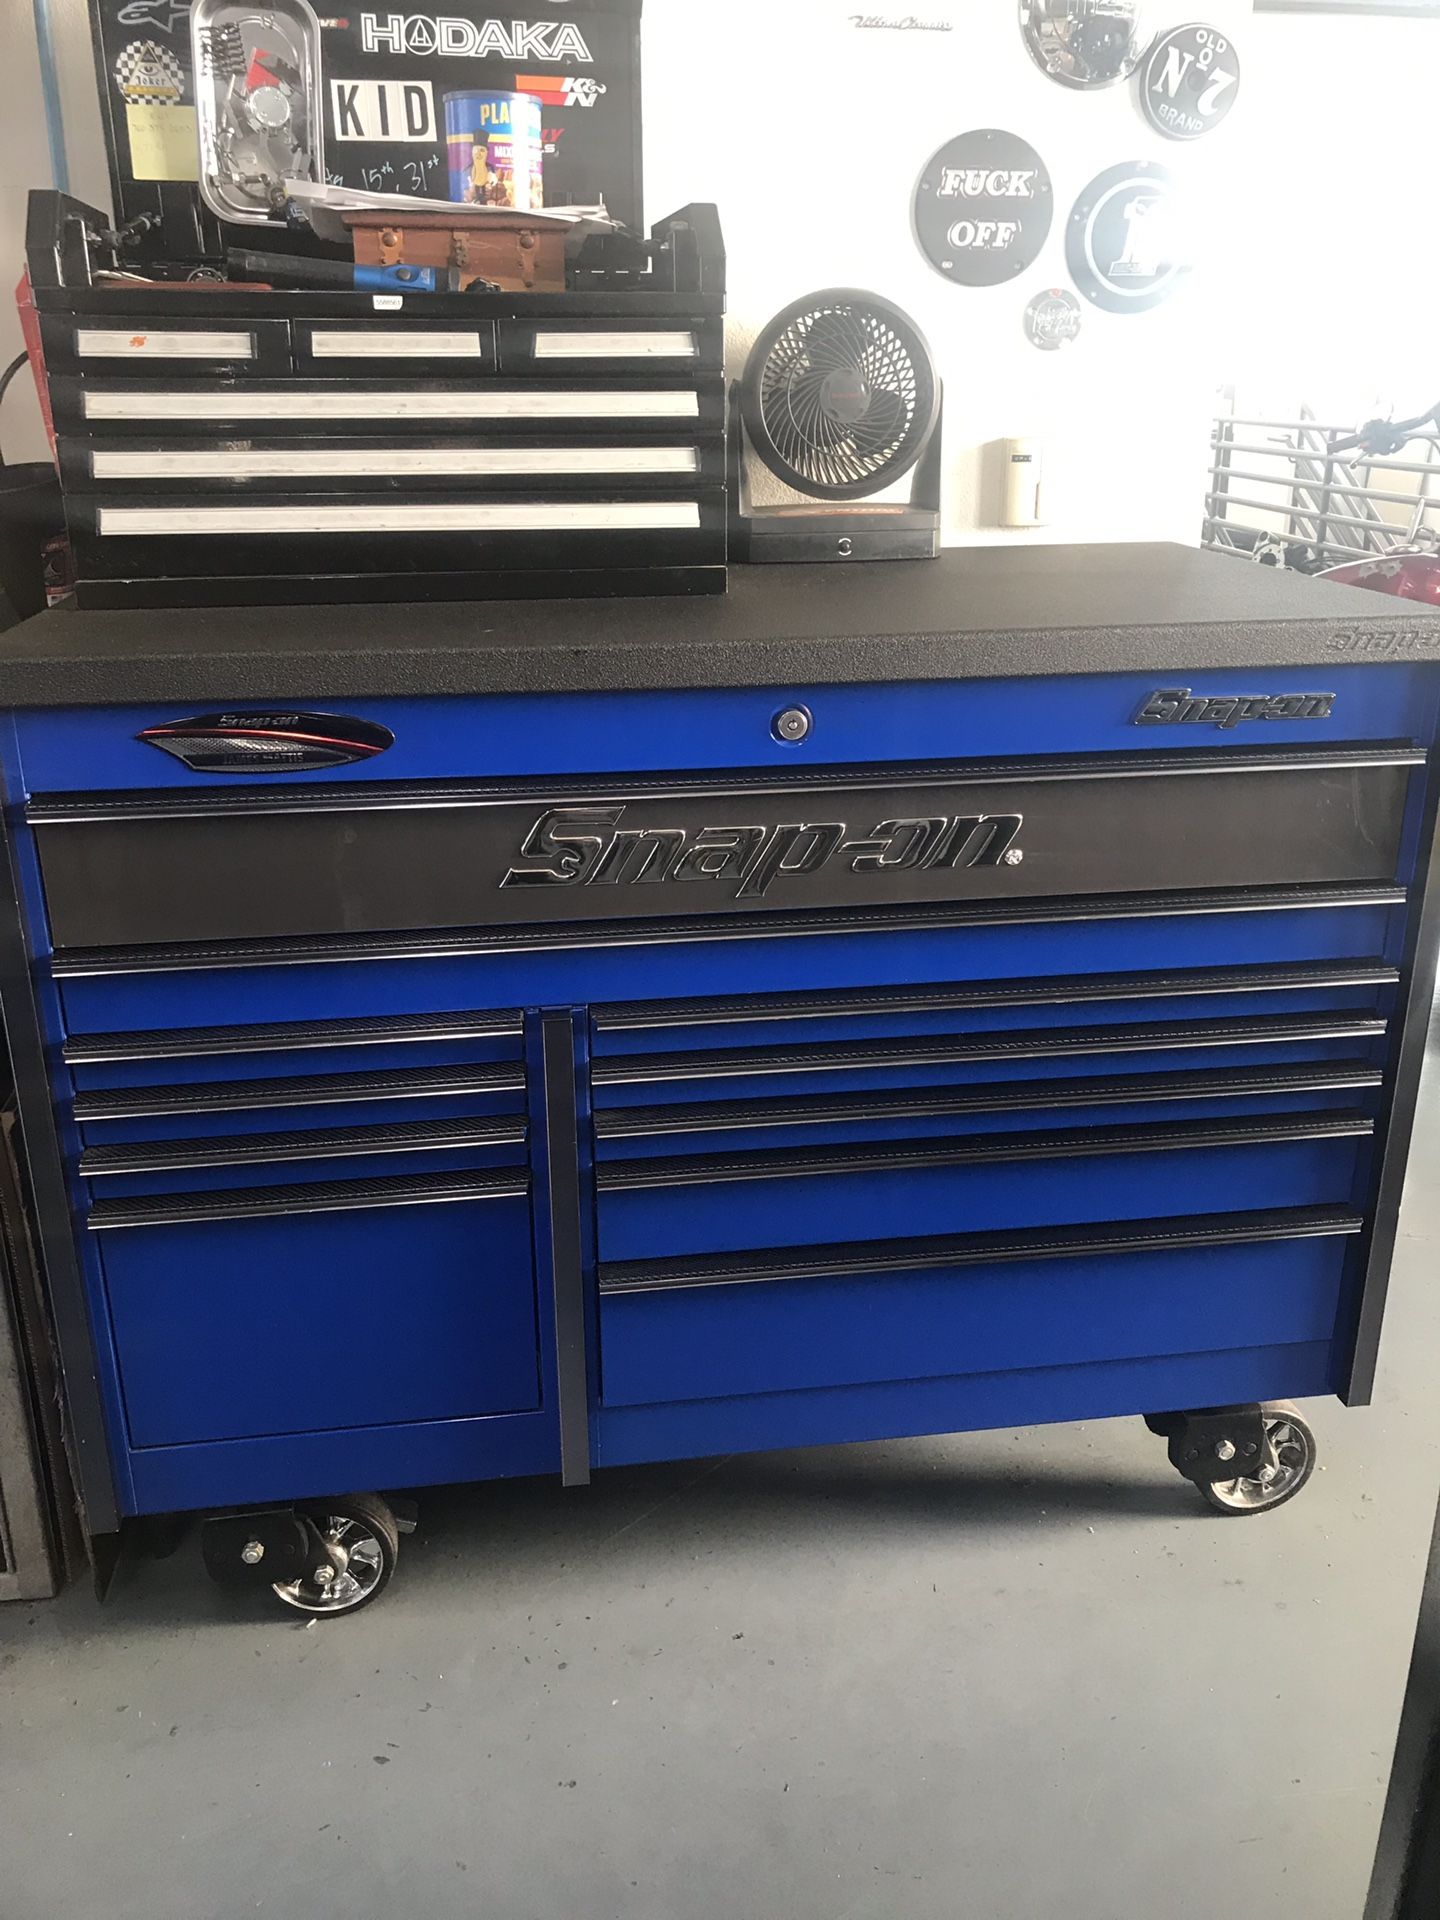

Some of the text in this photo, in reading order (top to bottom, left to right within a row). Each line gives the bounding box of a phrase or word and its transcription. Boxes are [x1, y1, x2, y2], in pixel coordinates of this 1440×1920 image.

[360, 13, 594, 62] HODAKA
[1195, 29, 1228, 54] OLD
[1208, 66, 1237, 116] 7
[337, 84, 430, 137] KID
[1158, 103, 1204, 131] BRAND
[938, 167, 1036, 198] FUCK
[948, 219, 1019, 249] OFF
[1134, 688, 1337, 729] Snap-on
